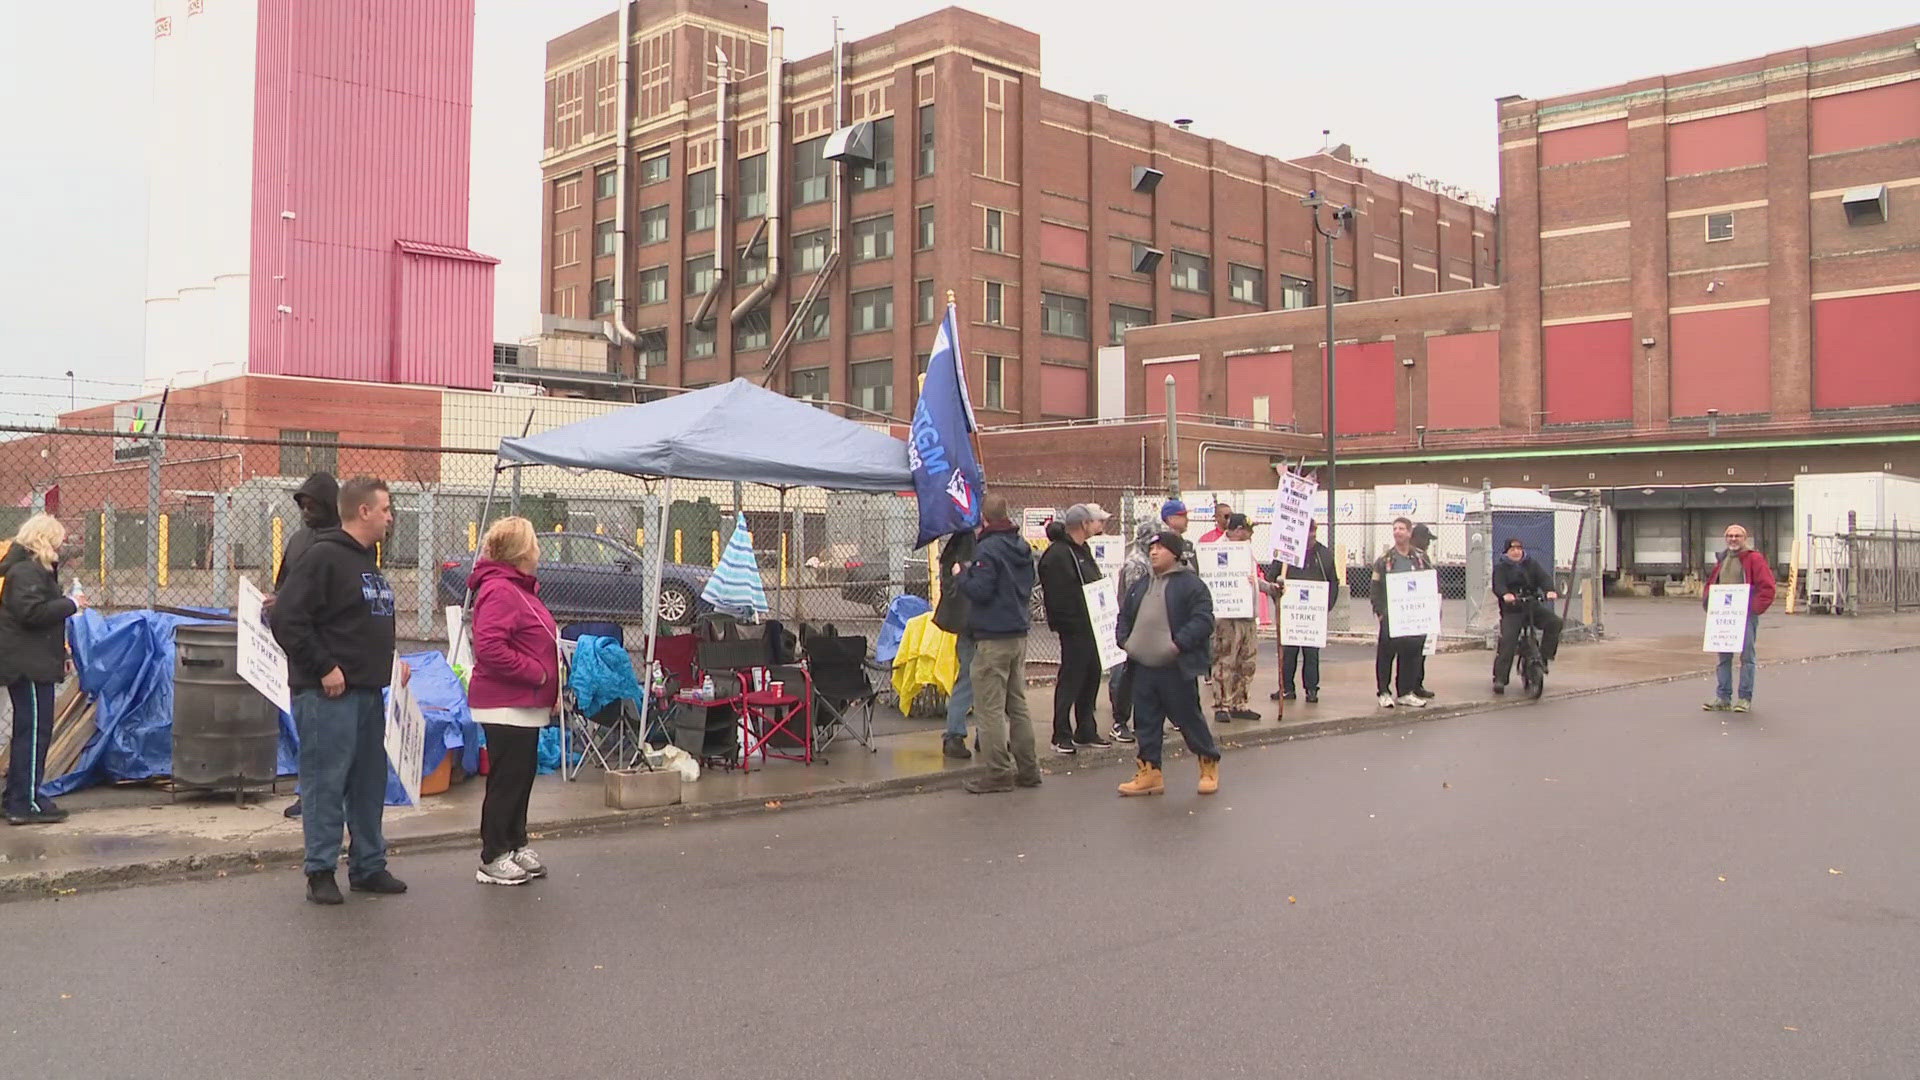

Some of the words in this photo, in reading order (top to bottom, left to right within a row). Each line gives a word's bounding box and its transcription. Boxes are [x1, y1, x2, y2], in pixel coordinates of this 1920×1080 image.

[914, 398, 951, 475] CTGM
[1209, 580, 1239, 589] STRIKE
[1290, 613, 1317, 622] STRIKE
[251, 636, 278, 666] STRIKE
